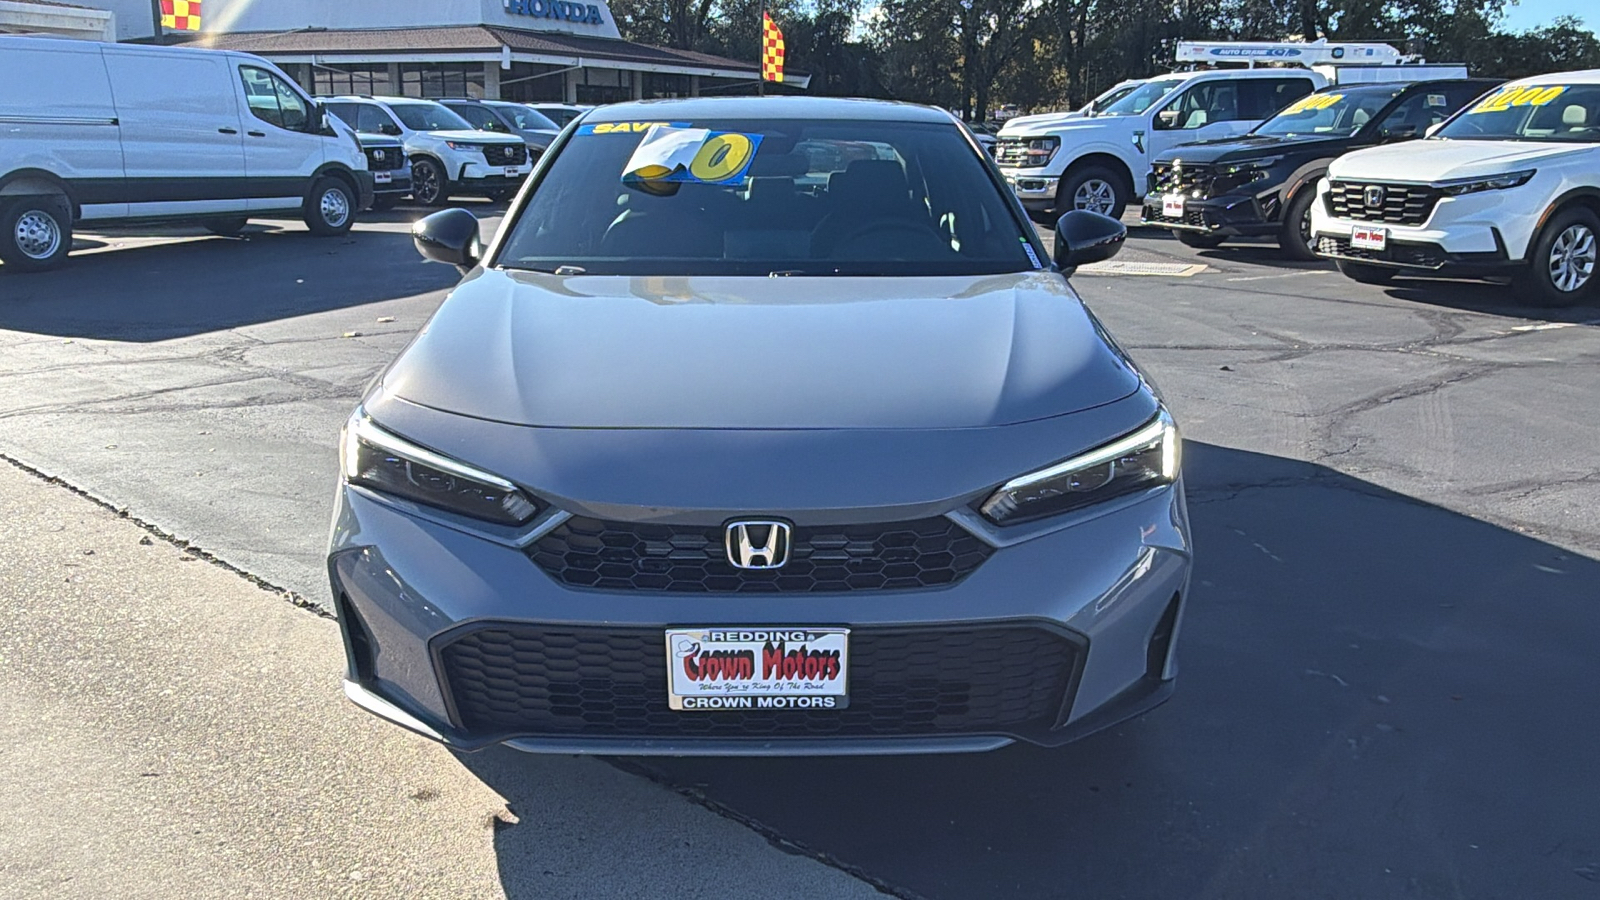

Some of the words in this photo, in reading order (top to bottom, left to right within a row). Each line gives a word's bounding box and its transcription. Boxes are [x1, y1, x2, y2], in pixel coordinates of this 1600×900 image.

[504, 0, 604, 25] HONDA
[1219, 48, 1240, 56] AUTO
[592, 122, 671, 134] SAV
[711, 631, 806, 643] REDDING
[683, 643, 755, 682] Crown
[762, 641, 841, 682] Motors
[699, 682, 722, 691] Where
[752, 682, 771, 691] King
[774, 682, 785, 692] Of
[787, 682, 801, 691] The
[804, 682, 824, 691] Road
[683, 696, 752, 708] CROWN
[757, 696, 836, 708] MOTORS
